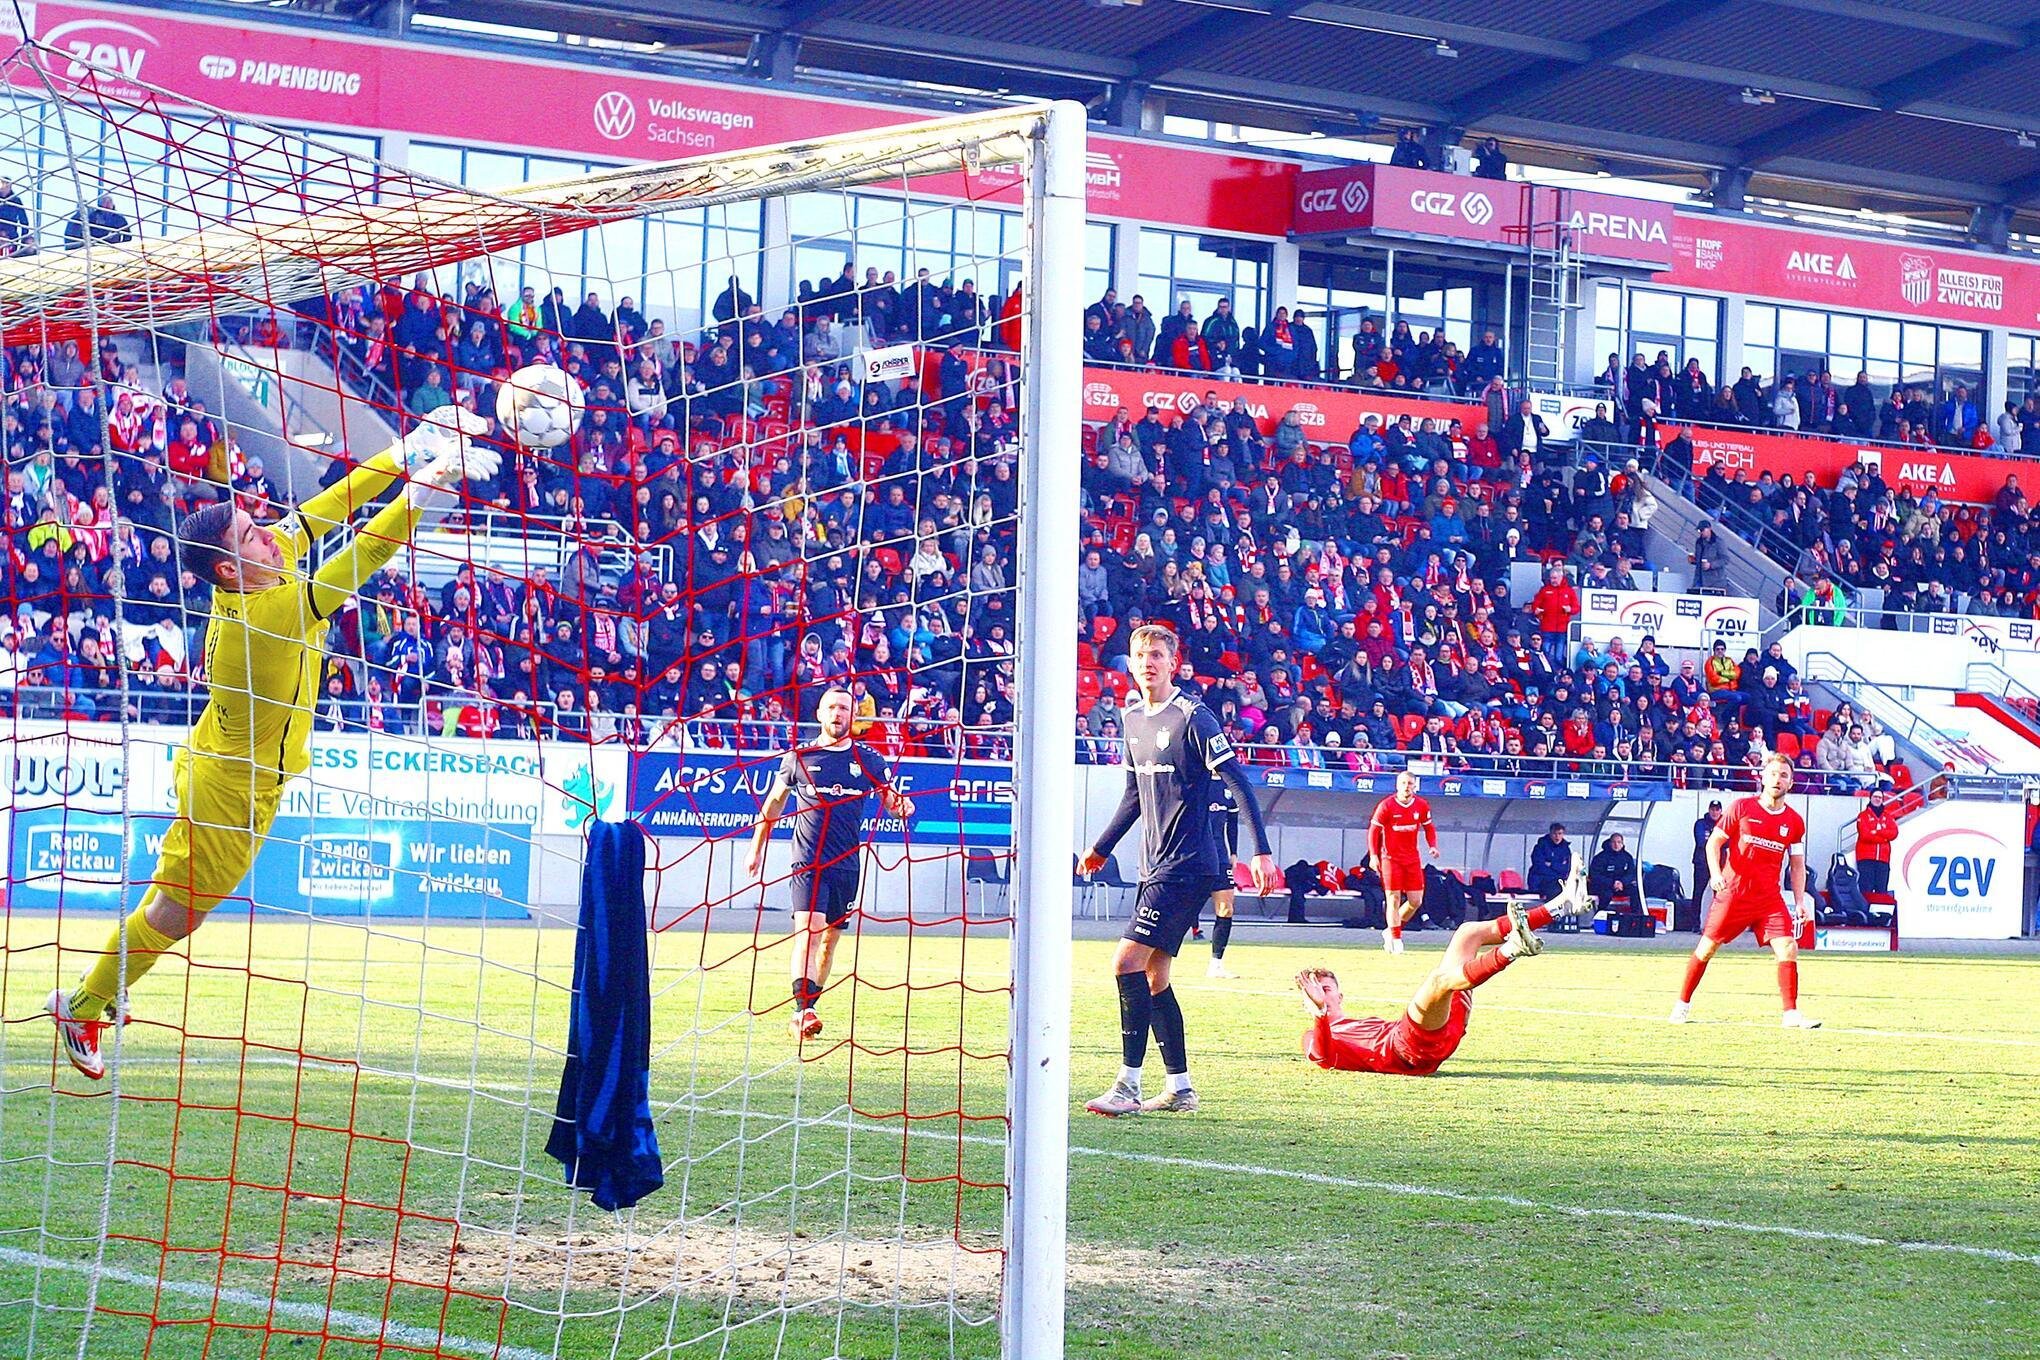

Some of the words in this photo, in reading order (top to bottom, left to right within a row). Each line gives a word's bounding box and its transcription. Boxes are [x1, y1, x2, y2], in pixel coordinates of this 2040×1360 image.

[66, 40, 146, 83] zev
[240, 60, 362, 96] PAPENBURG
[647, 98, 754, 130] Volkswagen
[647, 122, 716, 149] Sachsen
[1300, 188, 1338, 213] GGZ
[1410, 190, 1456, 217] GGZ
[1568, 210, 1669, 245] ARENA
[1786, 250, 1835, 276] AKE
[1939, 272, 1979, 290] ALLE(S)
[1980, 275, 2002, 292] FÜR
[1937, 286, 2003, 311] ZWICKAU
[1092, 392, 1120, 407] SZB
[1142, 391, 1176, 410] GGZ
[1299, 411, 1326, 427] SZB
[1898, 462, 1938, 483] AKE
[1632, 612, 1664, 632] zev
[1715, 618, 1747, 637] zev
[370, 749, 546, 776] ECKERSBACH
[4, 755, 125, 798] WOLF
[653, 766, 727, 794] ACPS
[1267, 773, 1285, 784] zev
[1356, 779, 1374, 790] zev
[1444, 782, 1462, 793] zev
[1529, 785, 1546, 796] zev
[1612, 787, 1629, 797] zev
[278, 789, 332, 816] HNE
[342, 791, 538, 826] Vertragsbindung
[860, 818, 910, 833] ACHSEN.
[50, 831, 100, 852] Radio
[321, 840, 369, 859] Radio
[37, 849, 116, 871] Zwickau
[409, 841, 447, 864] Wir
[450, 843, 512, 866] lieben
[310, 858, 384, 878] Zwickau
[1926, 855, 1997, 898] zev
[1139, 906, 1161, 922] CIC
